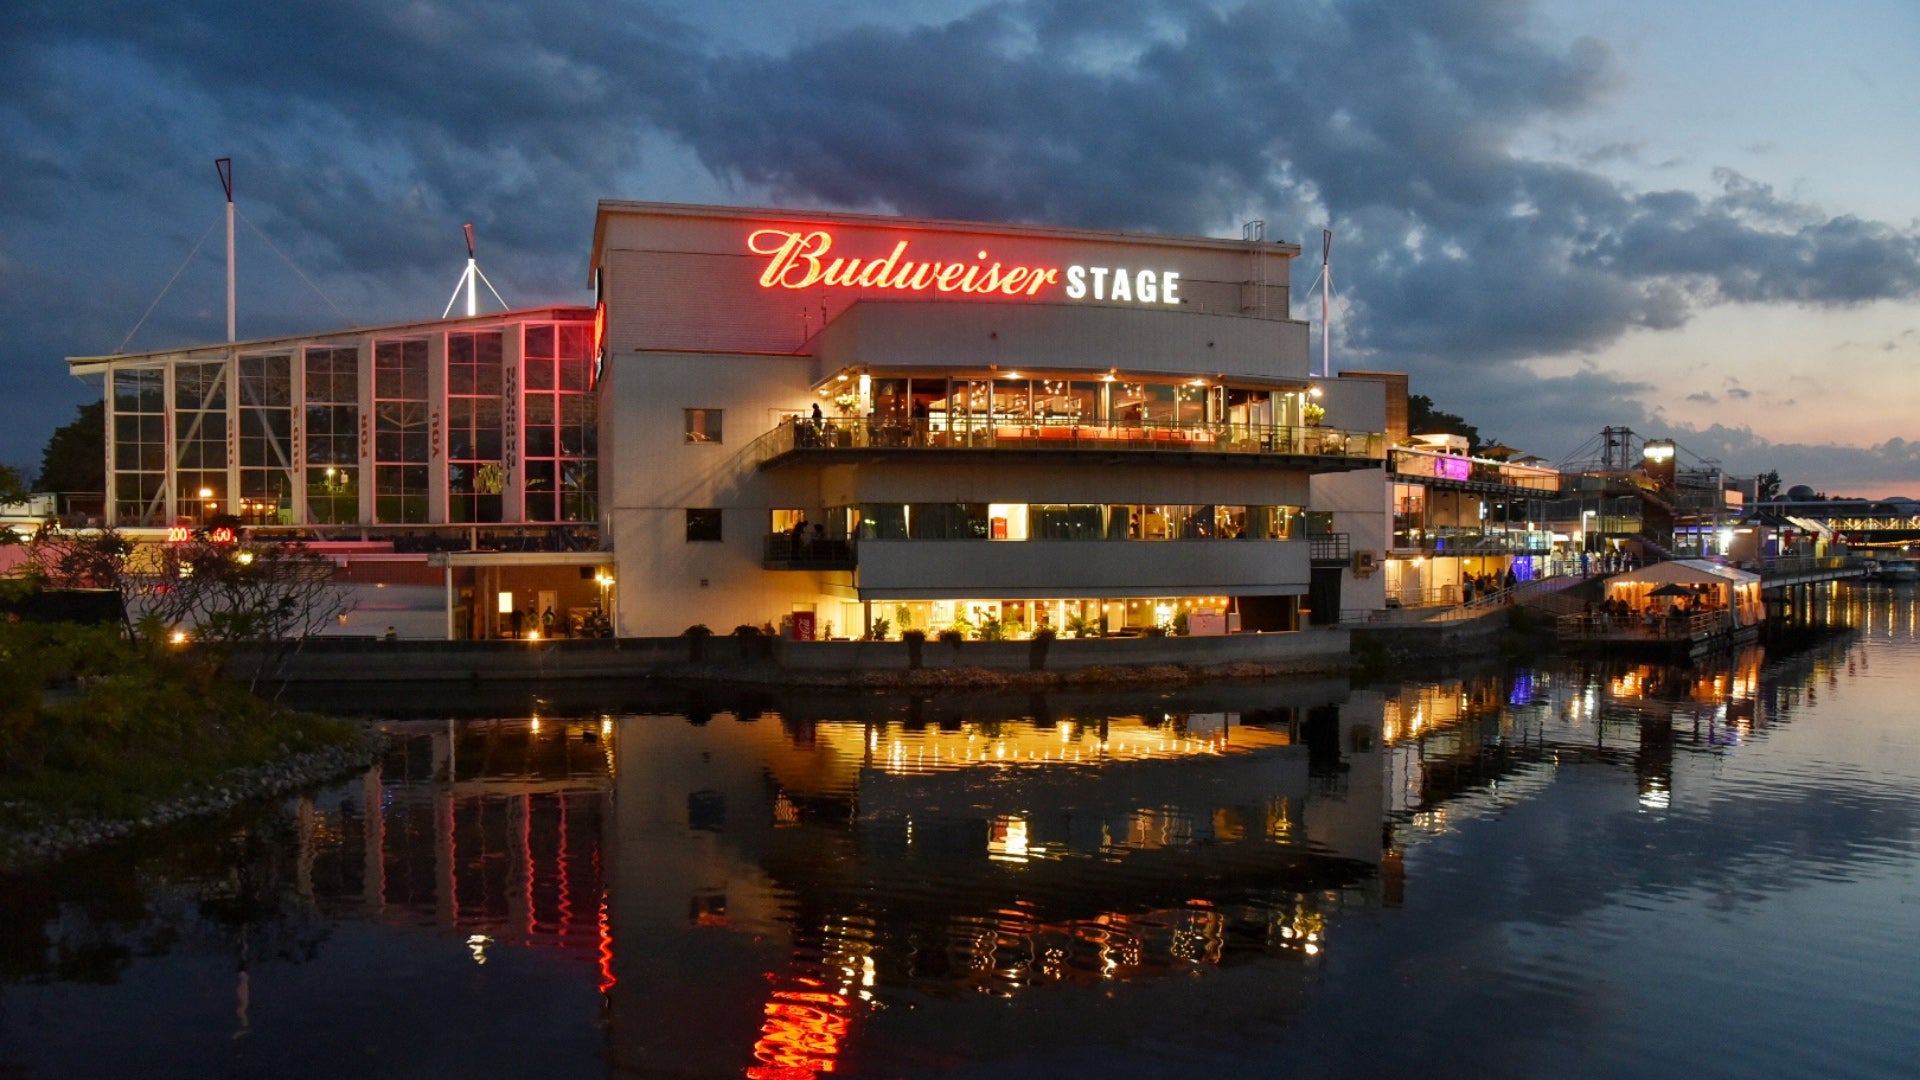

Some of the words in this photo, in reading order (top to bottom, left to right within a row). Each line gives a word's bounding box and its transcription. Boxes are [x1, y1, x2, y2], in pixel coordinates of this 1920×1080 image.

[748, 229, 1058, 296] Budweiser
[1066, 265, 1181, 305] STAGE
[167, 527, 188, 541] 200
